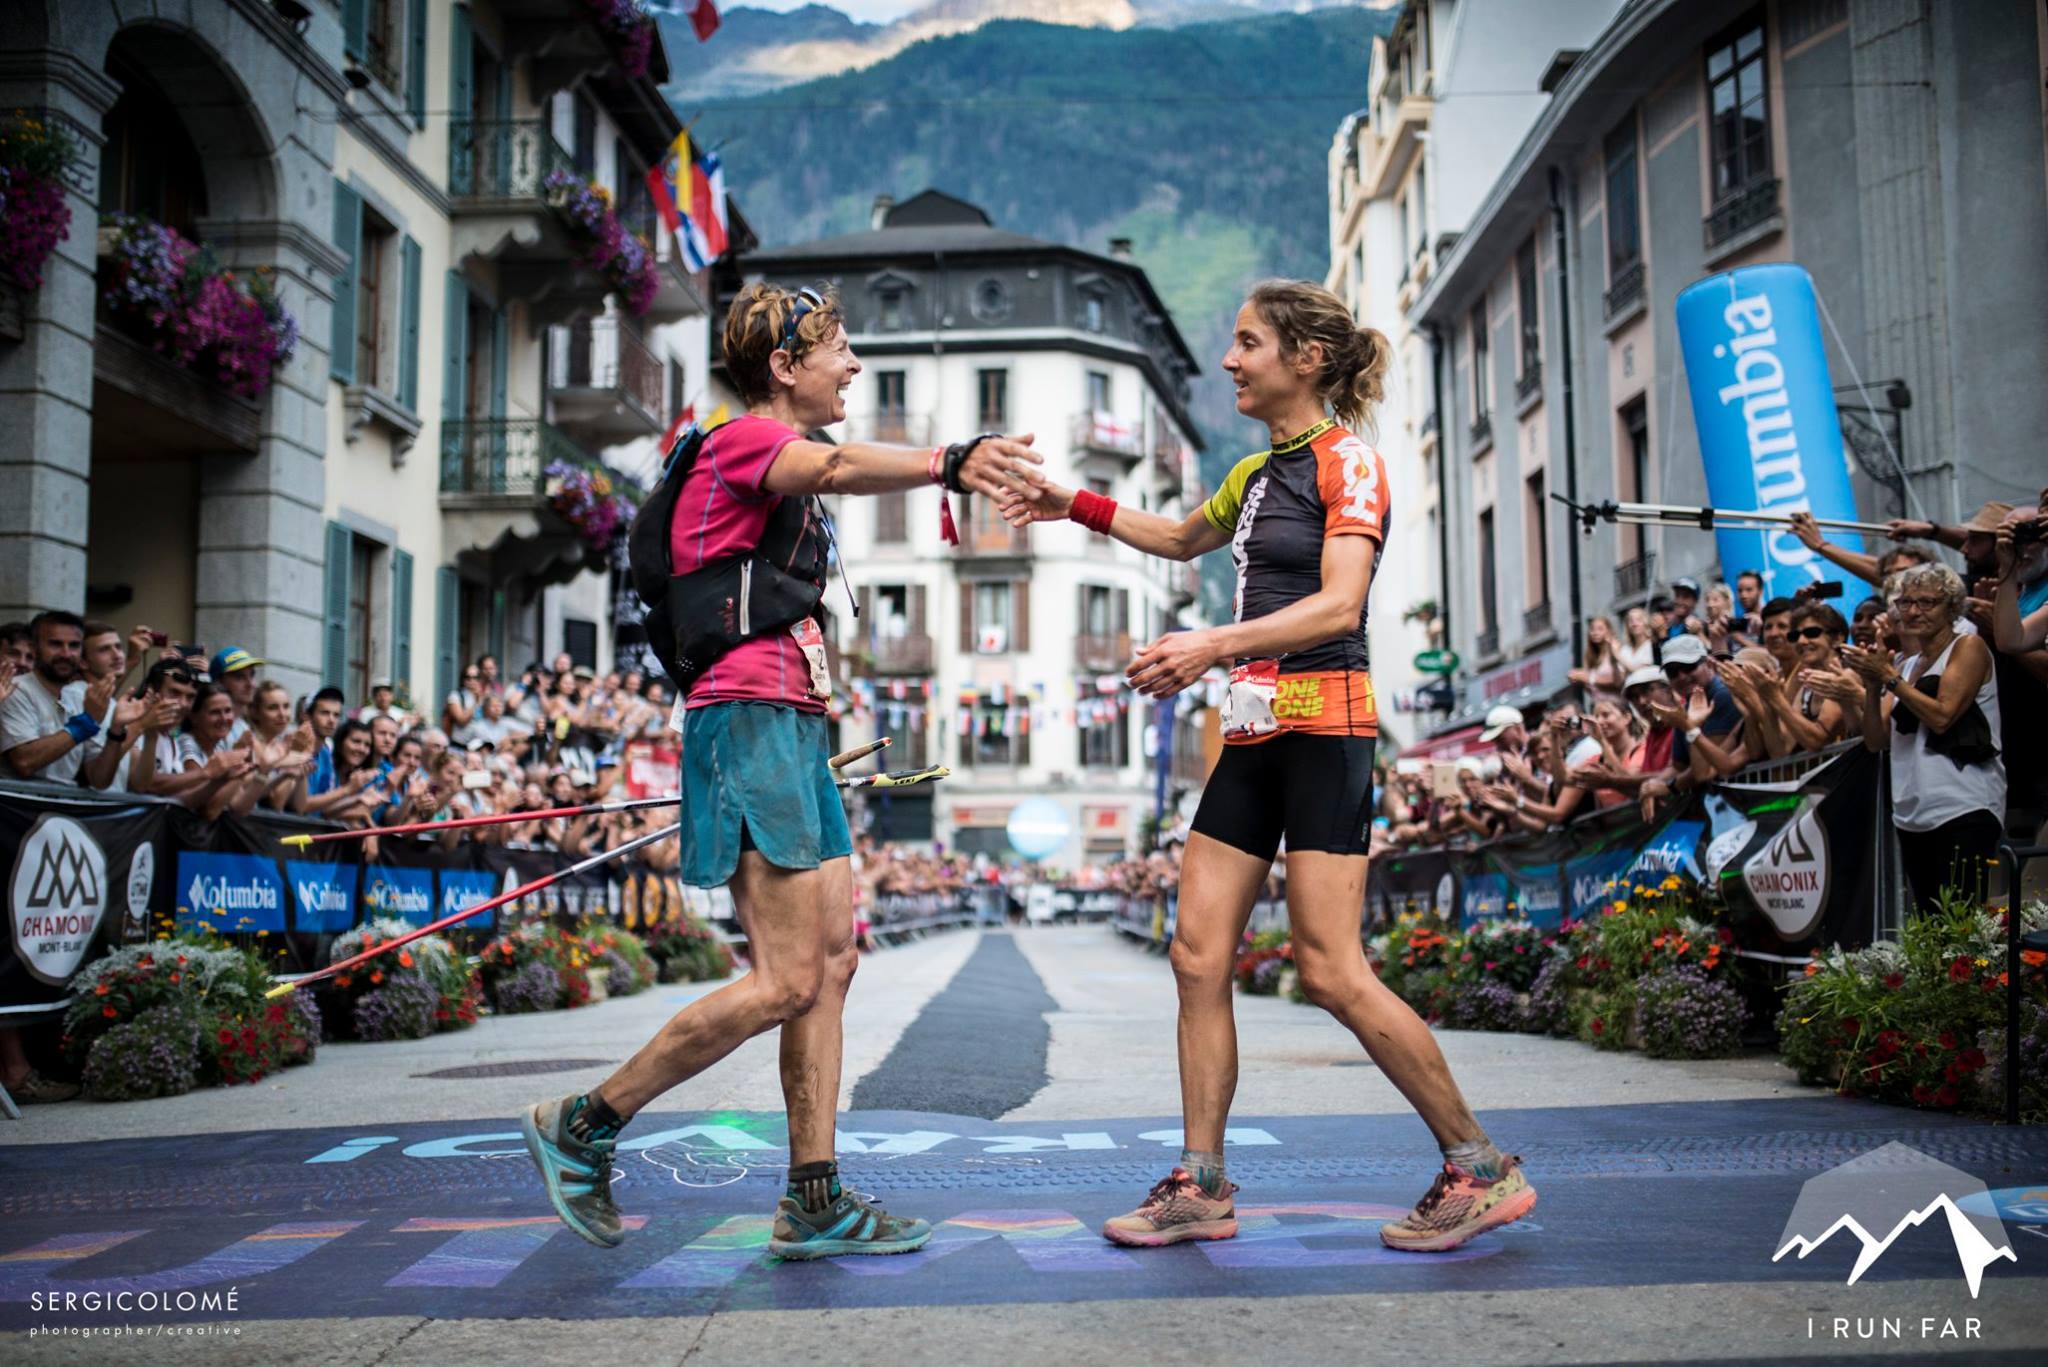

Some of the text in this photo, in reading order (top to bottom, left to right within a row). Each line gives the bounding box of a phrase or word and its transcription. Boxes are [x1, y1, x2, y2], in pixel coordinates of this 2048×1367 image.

[1713, 293, 1824, 590] olumbia
[1275, 678, 1321, 699] ONE
[1273, 696, 1325, 718] ONE
[893, 777, 916, 786] LEKI
[200, 875, 278, 910] Columbia
[1749, 871, 1819, 893] CHAMONIX
